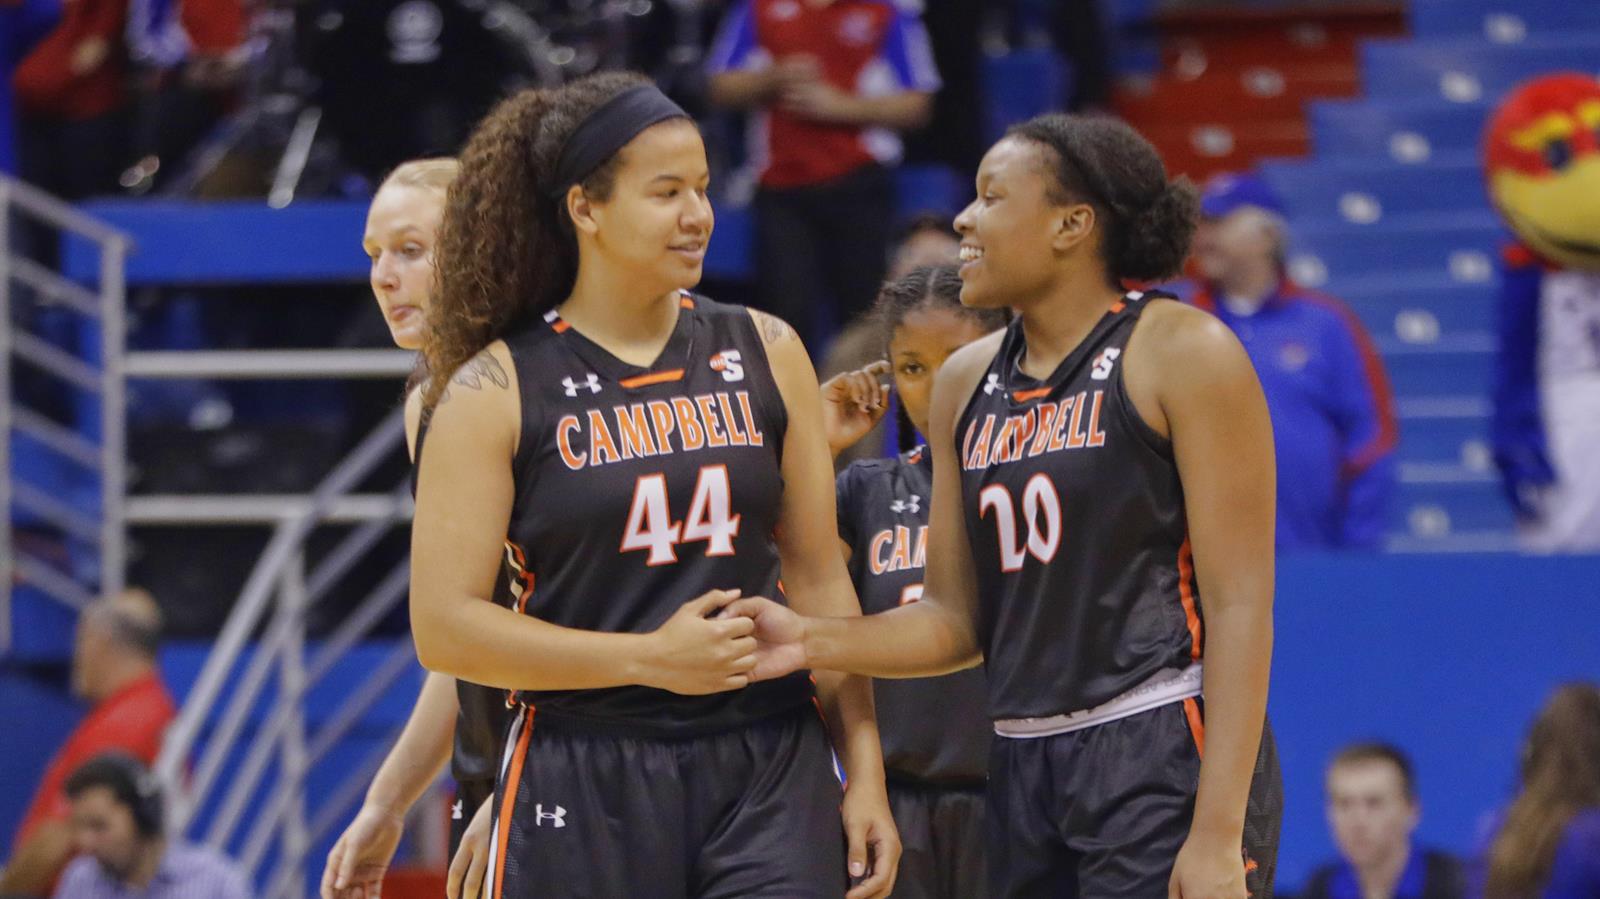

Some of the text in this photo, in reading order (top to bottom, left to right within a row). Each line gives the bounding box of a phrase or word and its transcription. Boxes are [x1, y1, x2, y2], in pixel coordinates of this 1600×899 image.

[556, 391, 763, 470] CAMPBELL
[619, 464, 741, 567] 44
[980, 473, 1063, 573] 20
